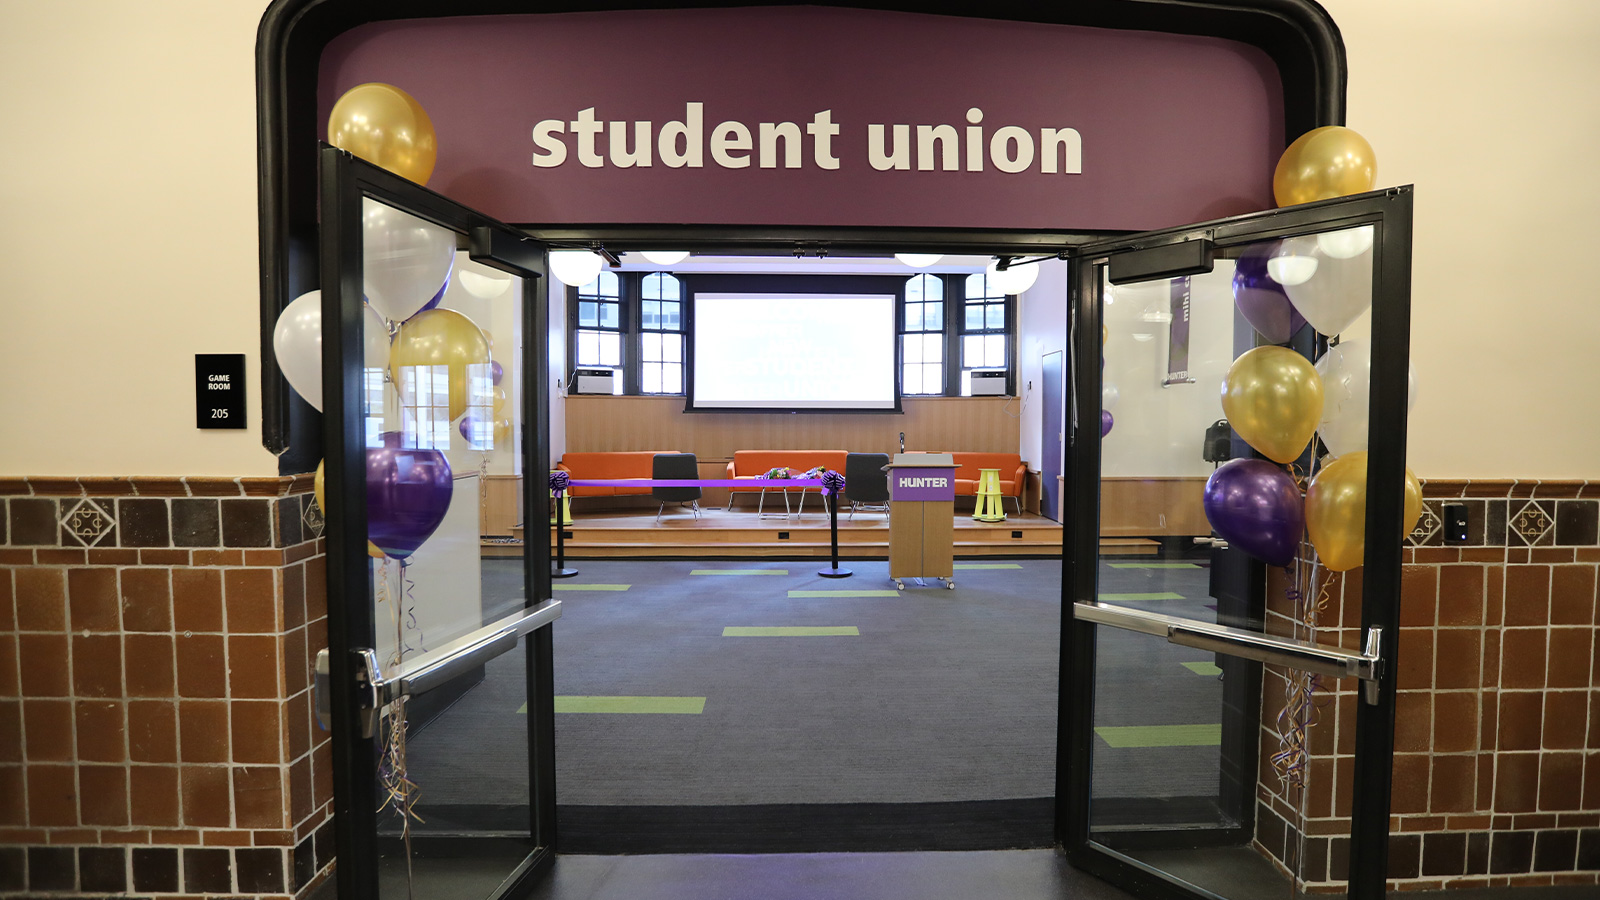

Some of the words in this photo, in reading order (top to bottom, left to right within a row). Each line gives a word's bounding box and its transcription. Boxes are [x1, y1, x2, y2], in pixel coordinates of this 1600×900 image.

[531, 102, 840, 171] student
[867, 107, 1083, 175] union
[208, 374, 230, 382] GAME
[1167, 370, 1188, 381] HUNTER
[208, 382, 231, 390] ROOM
[211, 408, 229, 419] 205
[899, 477, 948, 488] HUNTER
